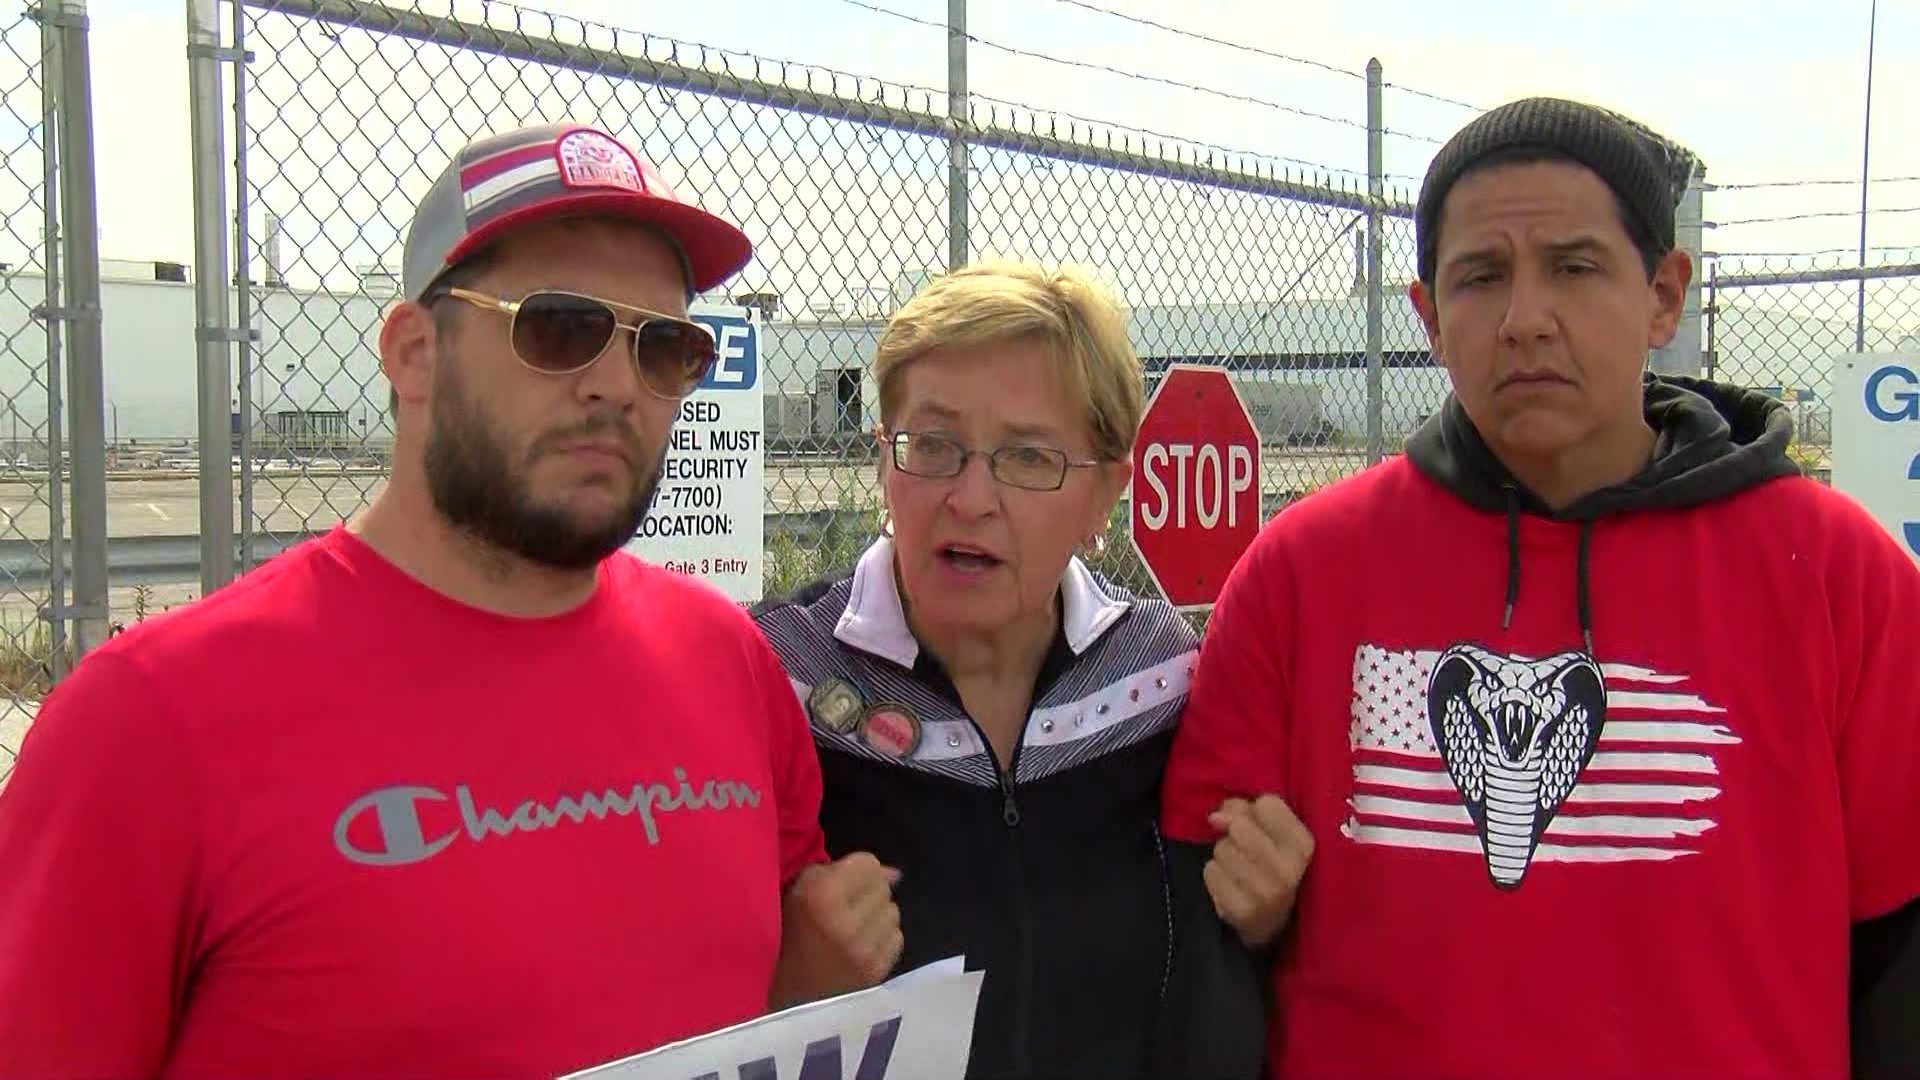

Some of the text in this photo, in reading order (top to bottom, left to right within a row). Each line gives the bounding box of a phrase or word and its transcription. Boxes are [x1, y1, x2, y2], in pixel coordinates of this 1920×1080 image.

[702, 324, 750, 383] E
[676, 402, 720, 422] SED
[710, 431, 760, 450] MUST
[1141, 443, 1253, 531] STOP
[701, 559, 710, 575] 3
[715, 558, 748, 575] Entry
[333, 765, 761, 867] Champion
